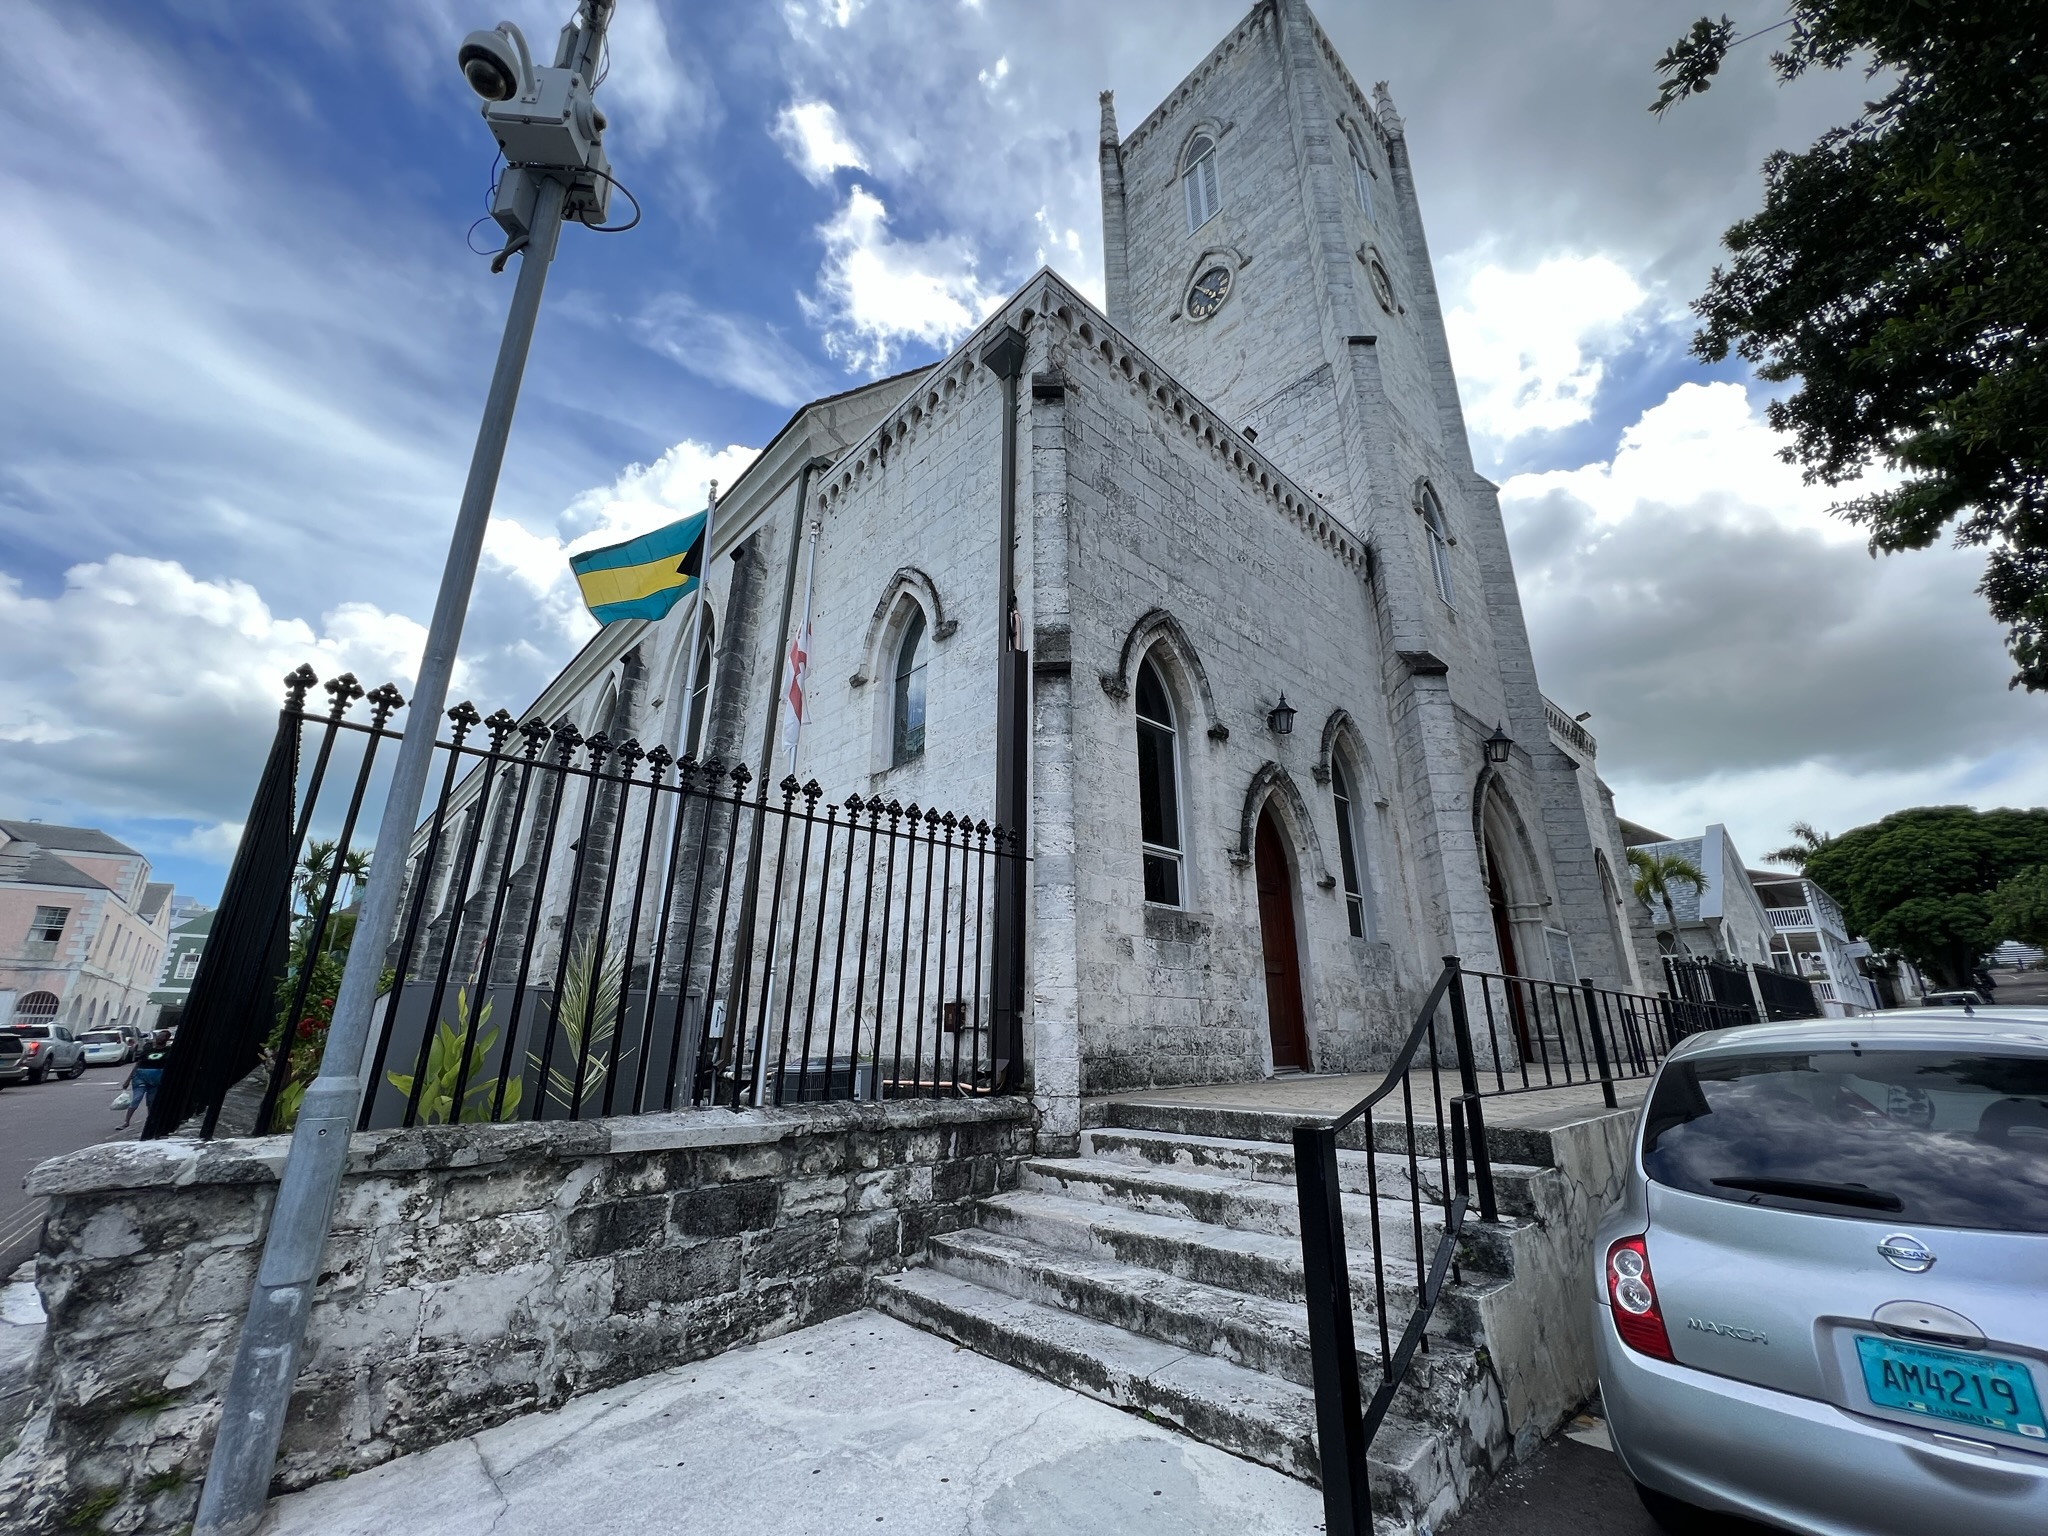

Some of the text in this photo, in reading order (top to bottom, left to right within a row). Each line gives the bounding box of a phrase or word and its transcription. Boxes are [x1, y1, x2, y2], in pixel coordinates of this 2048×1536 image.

[1885, 1248, 1930, 1259] NISSAN
[1688, 1317, 1768, 1345] MARCH
[1882, 1359, 2019, 1415] AM4219
[1926, 1404, 1985, 1423] BAHAMAS
